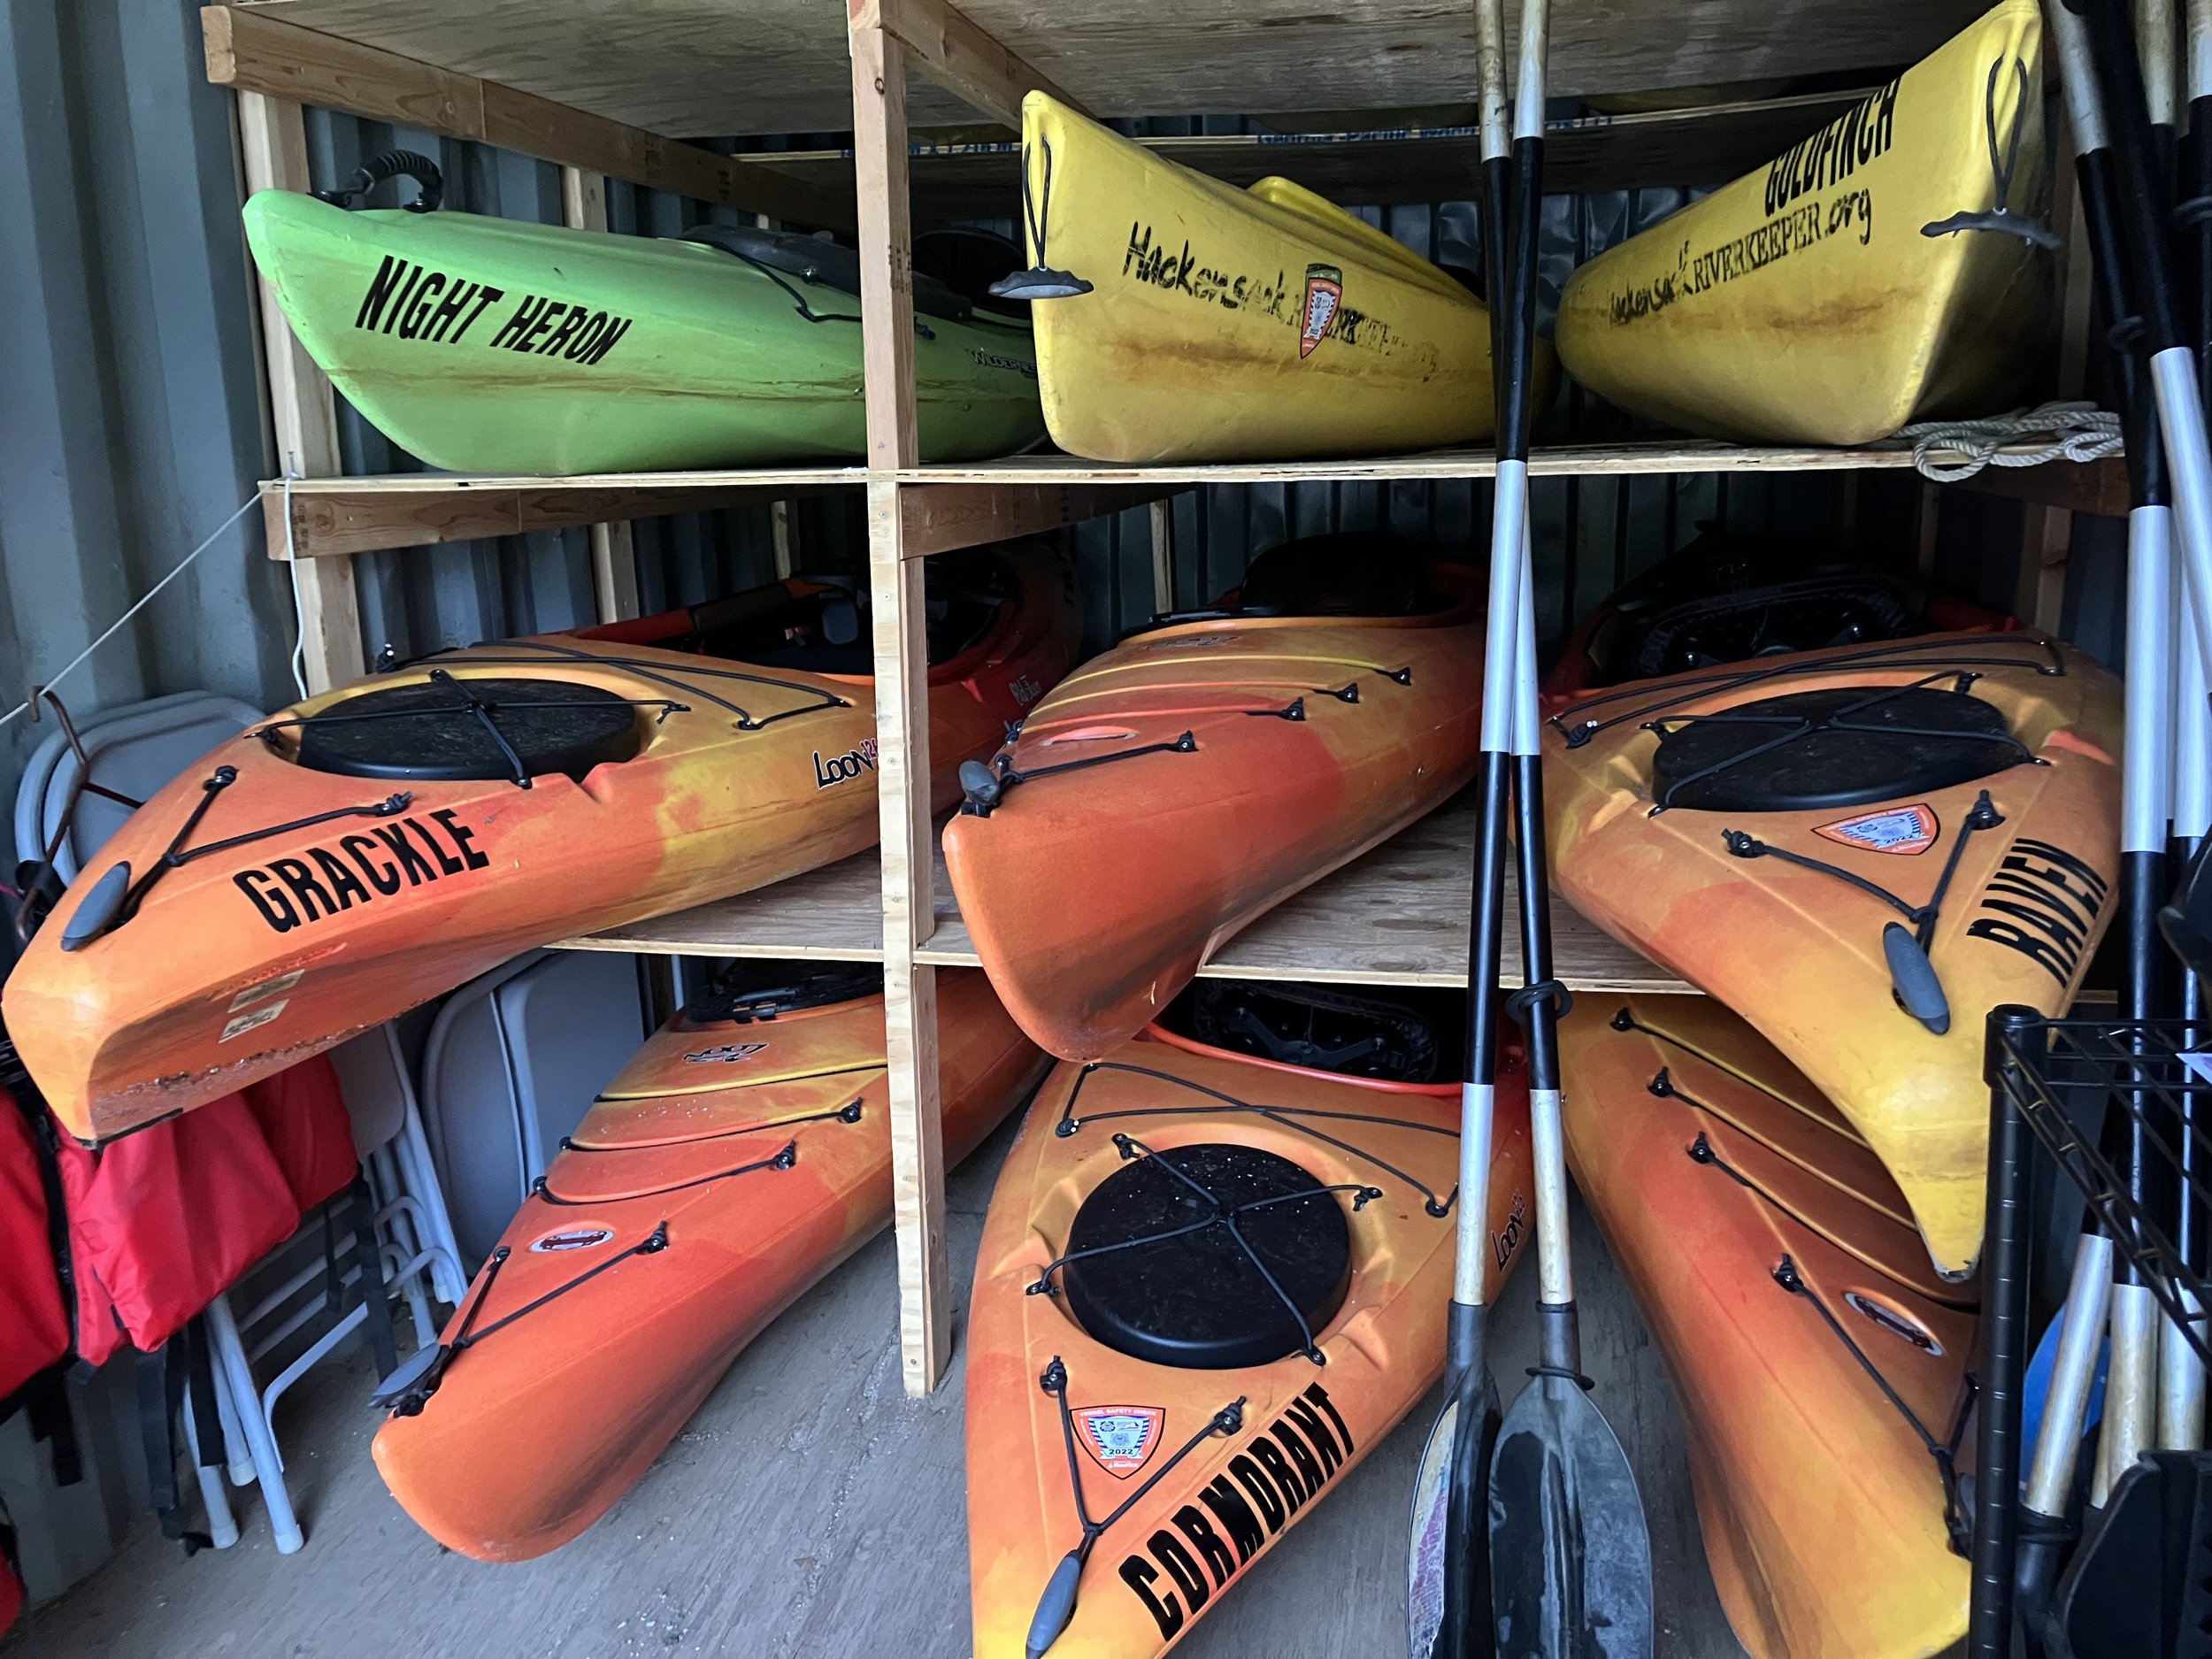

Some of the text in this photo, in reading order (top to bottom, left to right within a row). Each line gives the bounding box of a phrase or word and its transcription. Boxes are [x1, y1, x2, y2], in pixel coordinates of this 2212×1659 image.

[1765, 77, 1901, 217] GOLDFINCH
[355, 255, 633, 365] NIGHT HERON
[233, 809, 489, 933] GRACKLE
[1966, 838, 2108, 988] RAVEN
[1118, 1381, 1354, 1641] CORMORANT
